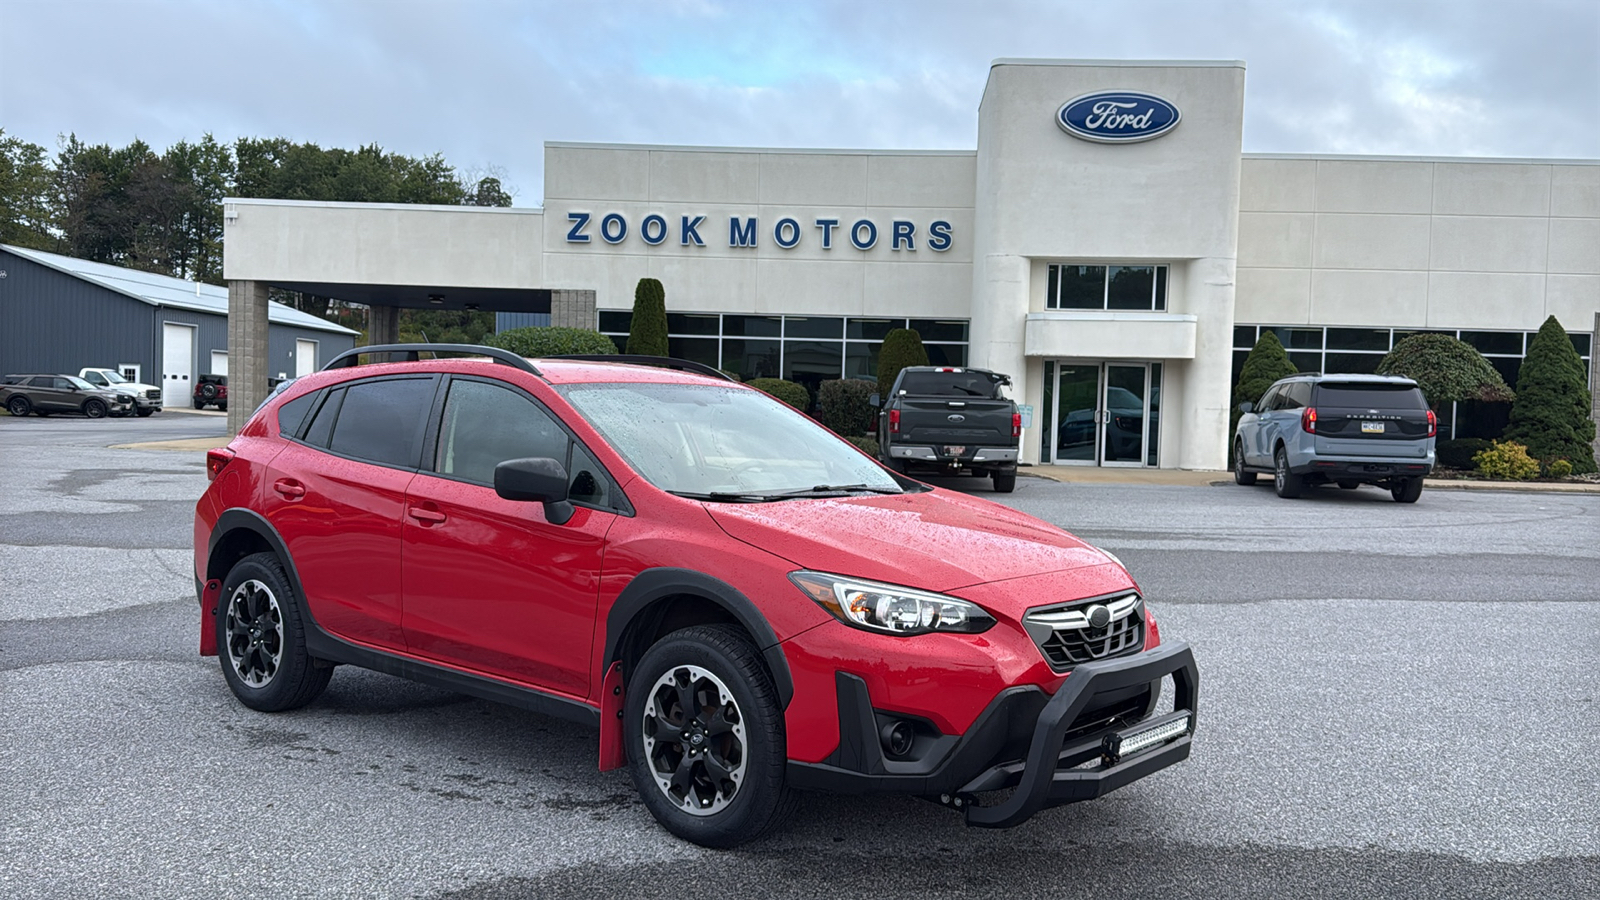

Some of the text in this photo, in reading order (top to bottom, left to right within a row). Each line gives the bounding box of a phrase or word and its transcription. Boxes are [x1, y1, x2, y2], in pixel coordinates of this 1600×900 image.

[1085, 101, 1155, 129] Ford
[566, 211, 953, 251] ZOOK MOTORS
